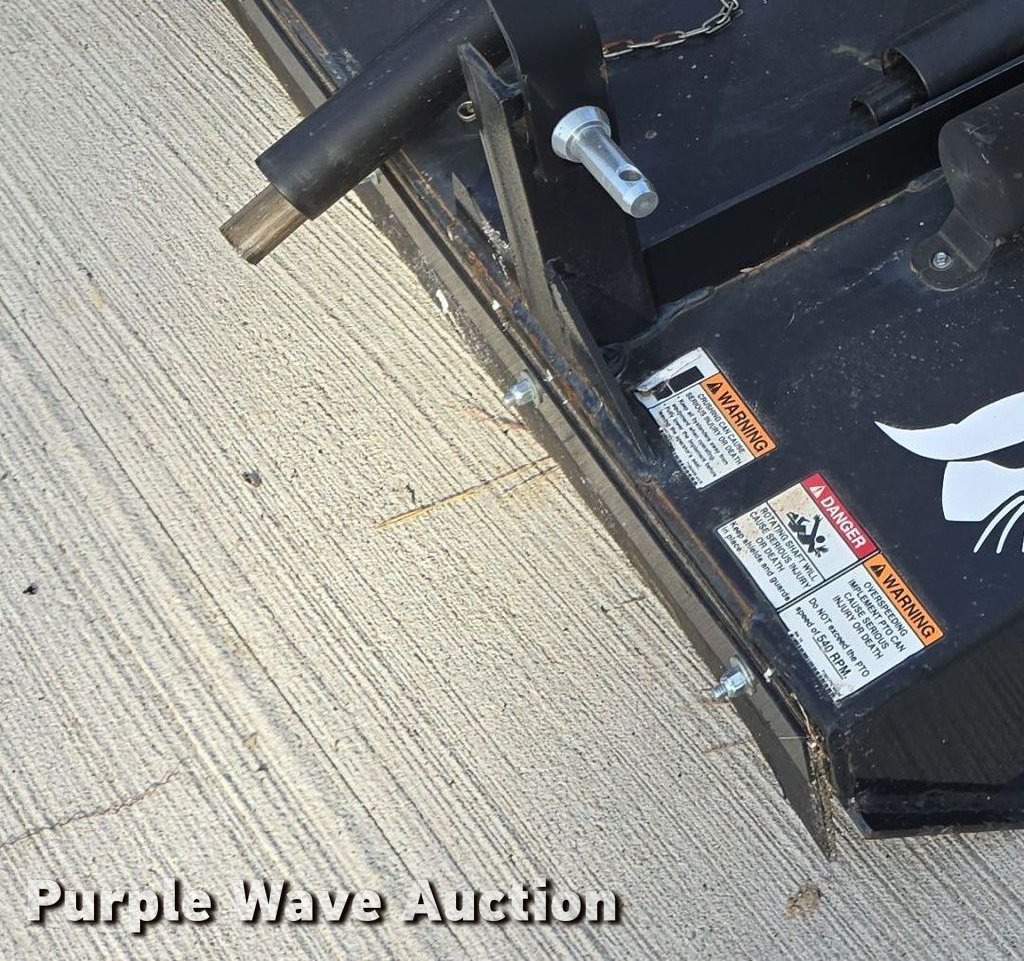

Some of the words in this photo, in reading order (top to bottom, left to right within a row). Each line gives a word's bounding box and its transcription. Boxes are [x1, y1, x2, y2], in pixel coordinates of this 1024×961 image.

[684, 392, 707, 416] SERIOUS
[702, 415, 721, 436] INJURY
[717, 436, 729, 445] OR
[724, 445, 743, 464] DEATH
[696, 393, 722, 422] CRUSHING
[718, 421, 731, 434] CAN
[727, 433, 745, 453] CAUSE
[715, 390, 769, 452] WARNING
[748, 510, 770, 534] CAUSE
[765, 532, 792, 564] SERIOUS
[787, 562, 811, 589] INJURY
[759, 506, 789, 541] ROTATING
[784, 540, 806, 564] SHAFT
[801, 562, 819, 581] WILL
[819, 495, 867, 549] DANGER
[728, 520, 746, 539] Keep
[742, 537, 764, 563] shields
[760, 562, 774, 576] and
[768, 576, 792, 602] guards
[755, 536, 768, 549] OR
[763, 547, 785, 572] DEATH
[793, 605, 814, 628] speed
[810, 626, 821, 636] of
[832, 594, 856, 622] INJURY
[851, 621, 865, 634] OR
[860, 633, 883, 659] DEATH
[842, 591, 866, 617] CAUSE
[861, 616, 890, 649] SERIOUS
[847, 578, 882, 620] IMPLEMENT
[877, 619, 893, 636] PTO
[889, 634, 906, 652] CAN
[862, 580, 908, 637] OVERSPEEDING
[880, 573, 936, 639] WARNING
[808, 597, 820, 609] Do
[815, 607, 832, 625] NOT
[827, 623, 849, 649] exceed
[845, 648, 858, 662] the
[853, 660, 870, 678] PTO
[815, 633, 834, 653] 540
[829, 651, 853, 679] RPM.
